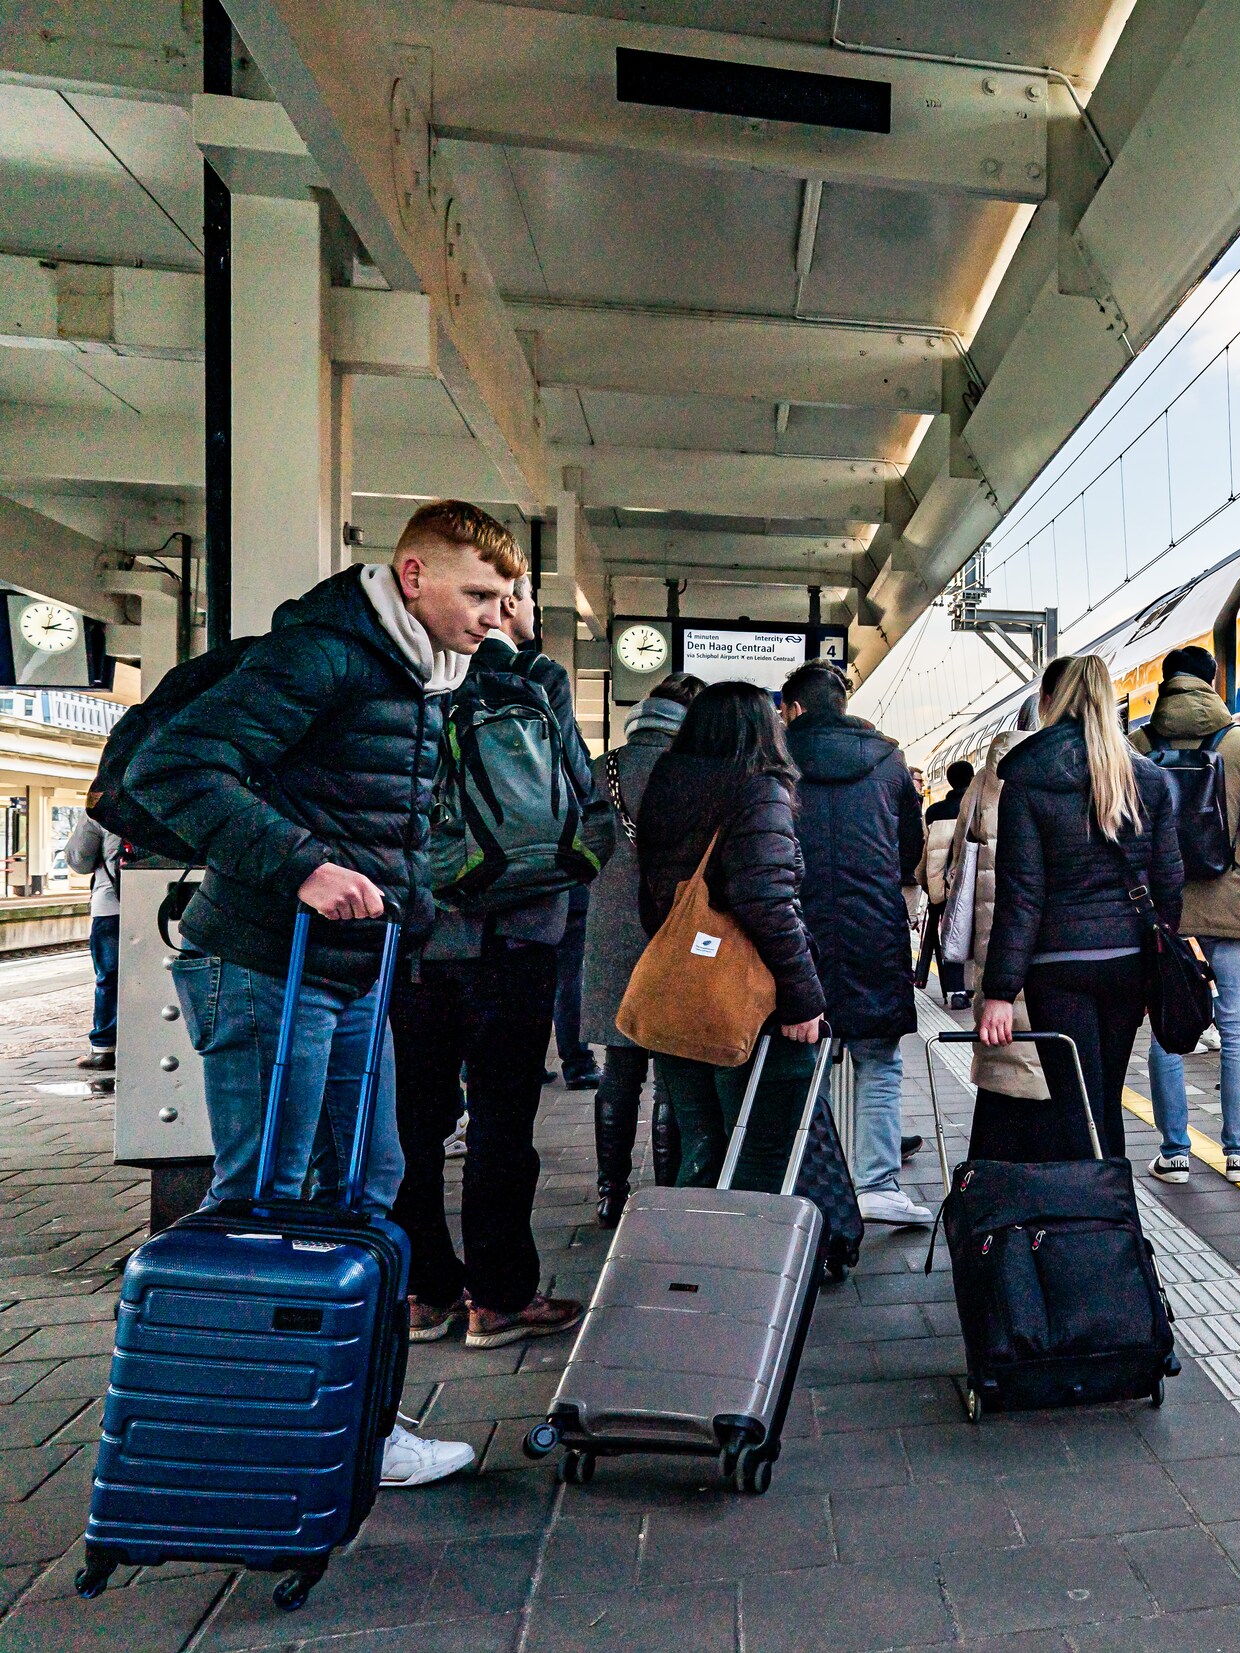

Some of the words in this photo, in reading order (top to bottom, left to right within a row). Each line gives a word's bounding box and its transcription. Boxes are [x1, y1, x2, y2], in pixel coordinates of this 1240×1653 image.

[687, 631, 692, 639] 4
[754, 635, 783, 643] Intercity
[687, 641, 706, 650] Den
[709, 642, 733, 653] Haag
[735, 642, 775, 653] Centraal
[827, 645, 836, 657] 4
[1170, 1160, 1188, 1168] NIKE
